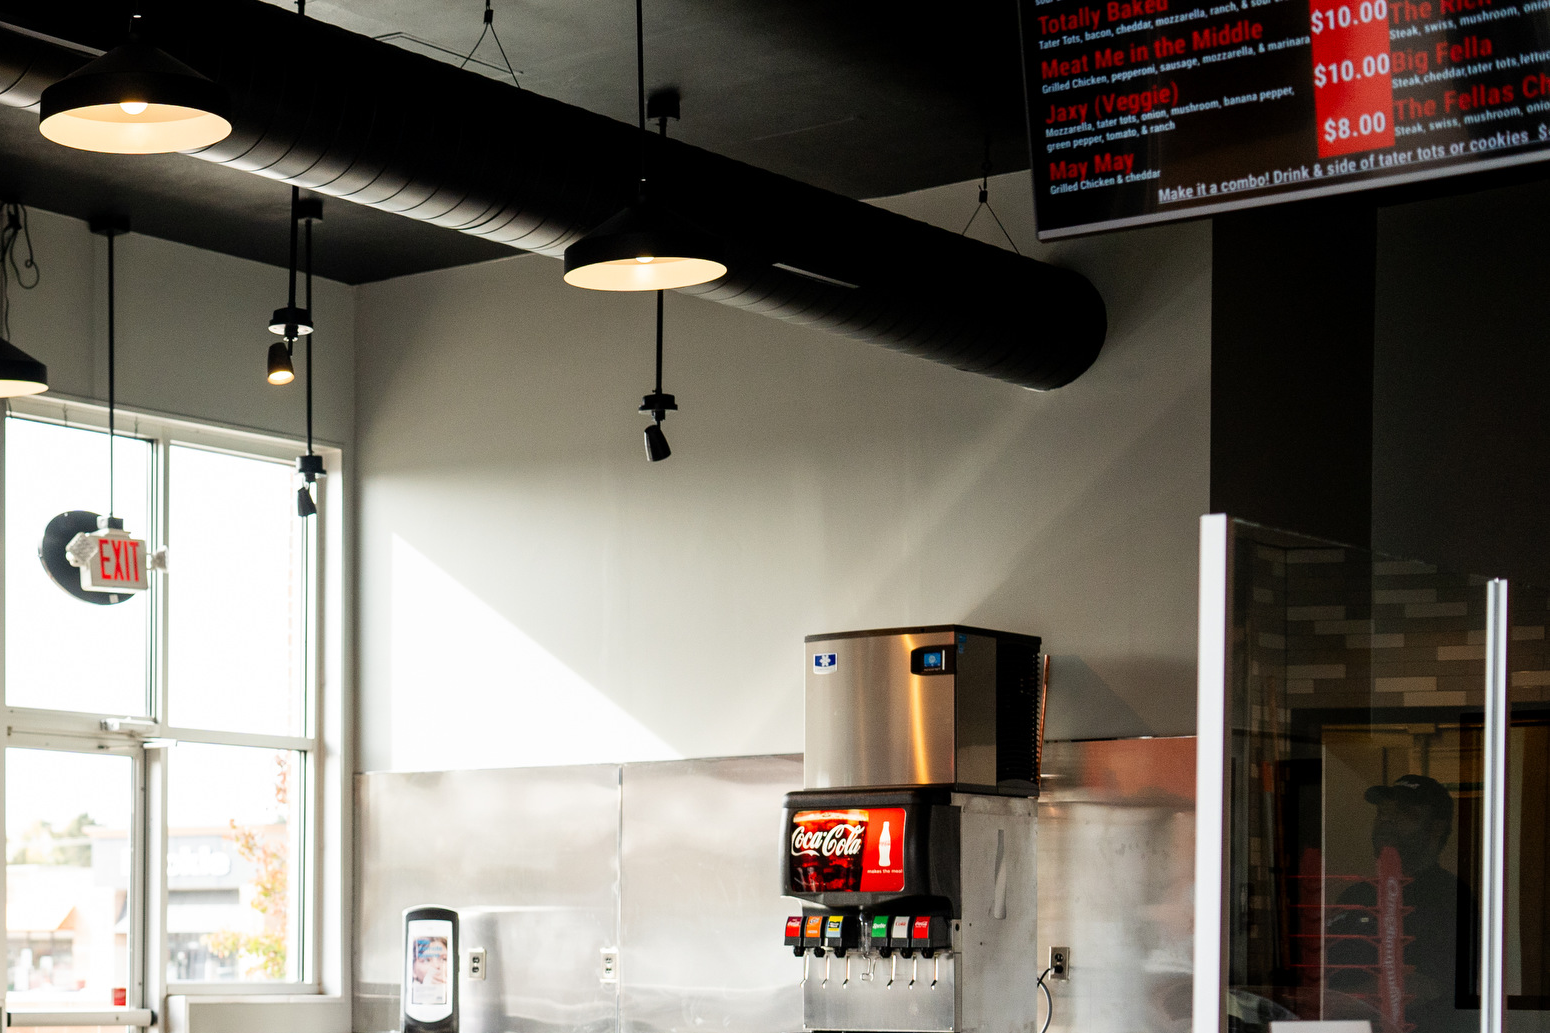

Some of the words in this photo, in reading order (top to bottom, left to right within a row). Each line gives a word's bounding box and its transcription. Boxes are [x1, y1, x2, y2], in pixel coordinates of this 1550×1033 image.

[1037, 6, 1101, 35] Totally
[1106, 0, 1169, 22] Baked
[1038, 37, 1061, 50] Tater
[1062, 34, 1084, 45] Tots,
[1084, 29, 1115, 41] bacon,
[1115, 19, 1155, 34] cheddar,
[1155, 8, 1208, 27] mozzarella,
[1209, 2, 1240, 16] ranch,
[1240, 0, 1249, 9] &
[1310, 0, 1388, 35] $10.00
[1389, 25, 1422, 40] Steak,
[1424, 19, 1457, 34] swiss,
[1459, 5, 1521, 27] mushroom,
[1390, 1, 1432, 24] The
[1041, 54, 1089, 80] Meat
[1094, 47, 1125, 70] Me
[1130, 42, 1149, 63] in
[1153, 36, 1187, 58] the
[1191, 19, 1264, 51] Middle
[1042, 80, 1071, 94] Grilled
[1071, 75, 1110, 89] Chicken,
[1111, 64, 1158, 84] pepperoni,
[1159, 57, 1201, 72] sausage,
[1202, 45, 1257, 64] mozzarella,
[1258, 42, 1266, 54] &
[1267, 35, 1311, 52] marinara
[1392, 48, 1428, 75] Big
[1436, 35, 1493, 65] Fella
[1313, 52, 1390, 88] $10.00
[1045, 102, 1089, 125] Jaxy
[1094, 81, 1179, 119] (Veggie)
[1045, 121, 1095, 138] Mozzarella,
[1096, 118, 1118, 129] tater
[1119, 114, 1140, 124] tots,
[1140, 108, 1170, 121] onion,
[1170, 99, 1223, 116] mushroom,
[1223, 92, 1258, 107] banana
[1259, 86, 1295, 103] pepper,
[1394, 98, 1437, 122] The
[1444, 83, 1514, 113] Fellas
[1046, 141, 1071, 153] green
[1072, 134, 1105, 149] pepper,
[1105, 128, 1140, 141] tomato,
[1141, 125, 1148, 136] &
[1150, 120, 1176, 134] ranch
[1323, 111, 1386, 143] $8.00
[1395, 123, 1427, 137] Steak,
[1429, 117, 1462, 131] swiss,
[1463, 105, 1524, 124] mushroom,
[1049, 160, 1089, 182] May
[1093, 152, 1135, 175] May
[1050, 181, 1079, 195] Grilled
[1080, 176, 1115, 190] Chicken
[1116, 174, 1123, 185] &
[1124, 169, 1161, 183] cheddar
[1158, 185, 1193, 203] Make
[1196, 182, 1207, 197] it
[1209, 183, 1218, 194] a
[1220, 171, 1271, 192] combo!
[1273, 165, 1310, 184] Drink
[1313, 163, 1323, 177] &
[1327, 158, 1357, 175] side
[1360, 154, 1375, 170] of
[1378, 148, 1413, 167] tater
[1417, 144, 1445, 162] tots
[1449, 141, 1465, 156] or
[1469, 130, 1530, 152] cookies
[98, 538, 141, 583] EXIT
[791, 823, 866, 857] Coca-Cola
